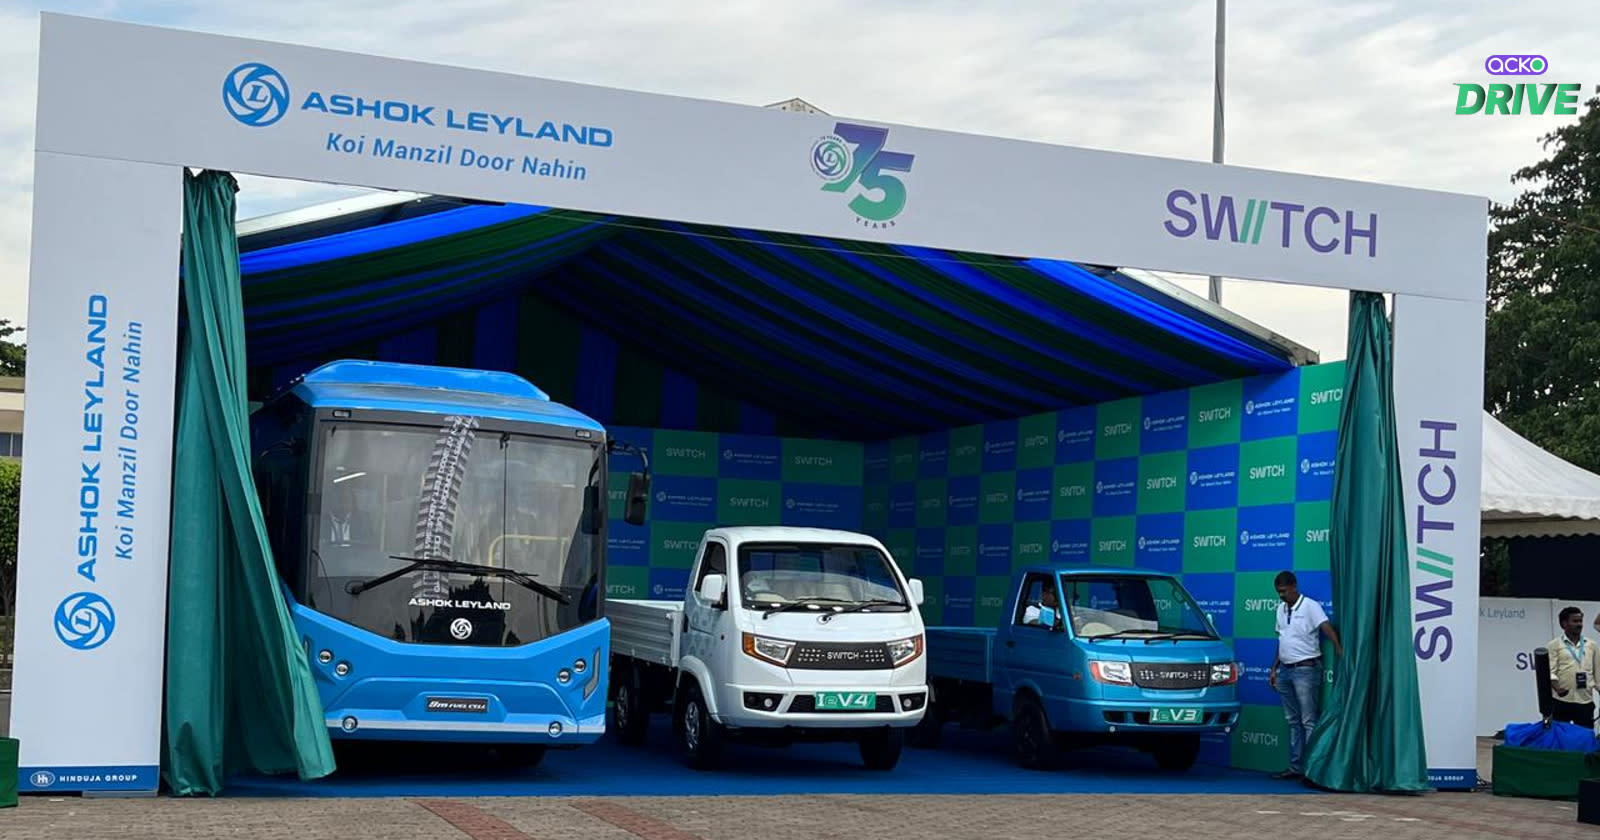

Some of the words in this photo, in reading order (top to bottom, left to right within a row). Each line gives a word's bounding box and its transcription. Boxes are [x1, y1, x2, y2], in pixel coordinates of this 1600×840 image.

[301, 92, 436, 126] ASHOK
[447, 109, 612, 148] LEYLAND
[326, 132, 364, 156] Koi
[373, 139, 452, 166] Manzil
[460, 150, 515, 173] Door
[521, 156, 587, 181] Nahin
[83, 294, 107, 452] LEYLAND
[122, 321, 142, 383] Nahin
[120, 390, 139, 440] Door
[117, 447, 137, 519] Manzil
[77, 461, 101, 583] ASHOK
[115, 525, 134, 560] Koi
[408, 598, 453, 608] ASHOK
[455, 600, 511, 610] LEYLAND
[59, 775, 101, 783] HINDUJA
[104, 774, 137, 782] GROUP
